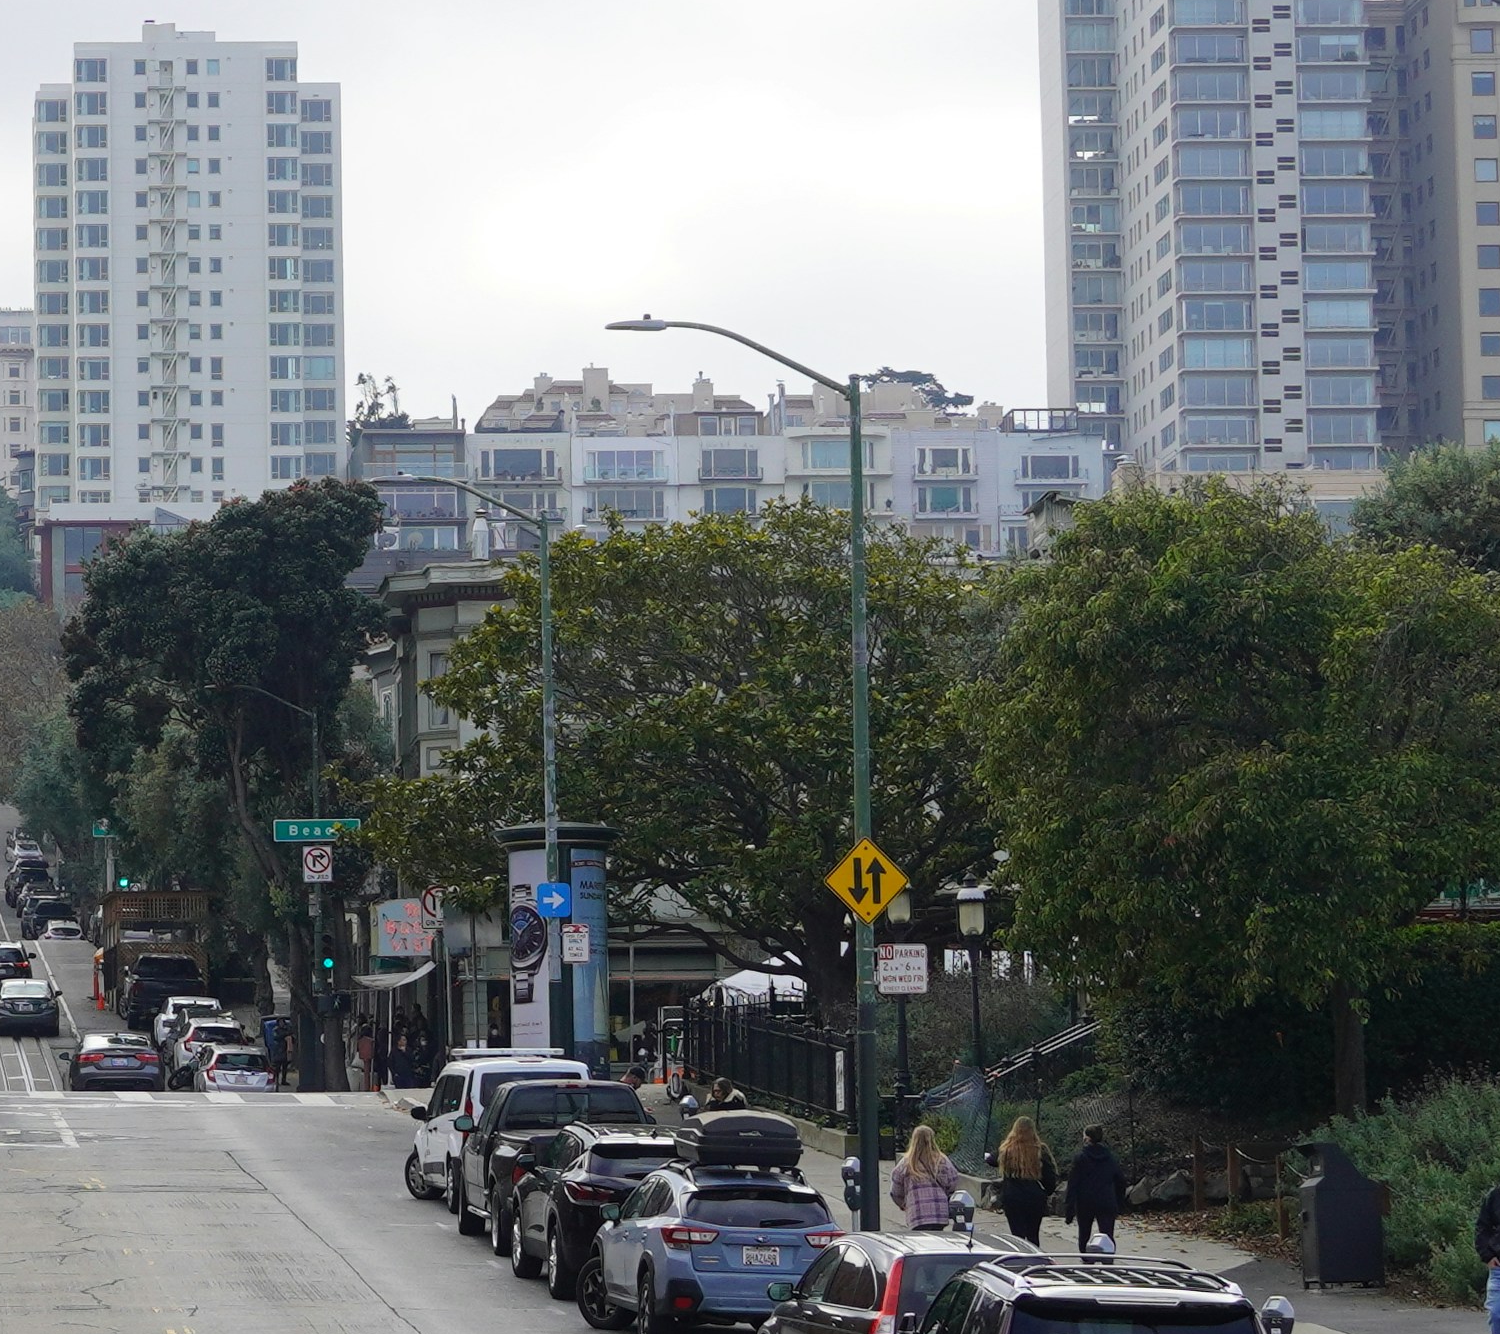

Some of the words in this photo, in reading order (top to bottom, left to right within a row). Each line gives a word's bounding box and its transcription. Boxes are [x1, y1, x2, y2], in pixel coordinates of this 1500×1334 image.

[288, 824, 334, 836] Beac
[880, 945, 893, 959] NO
[894, 948, 925, 958] PARKING
